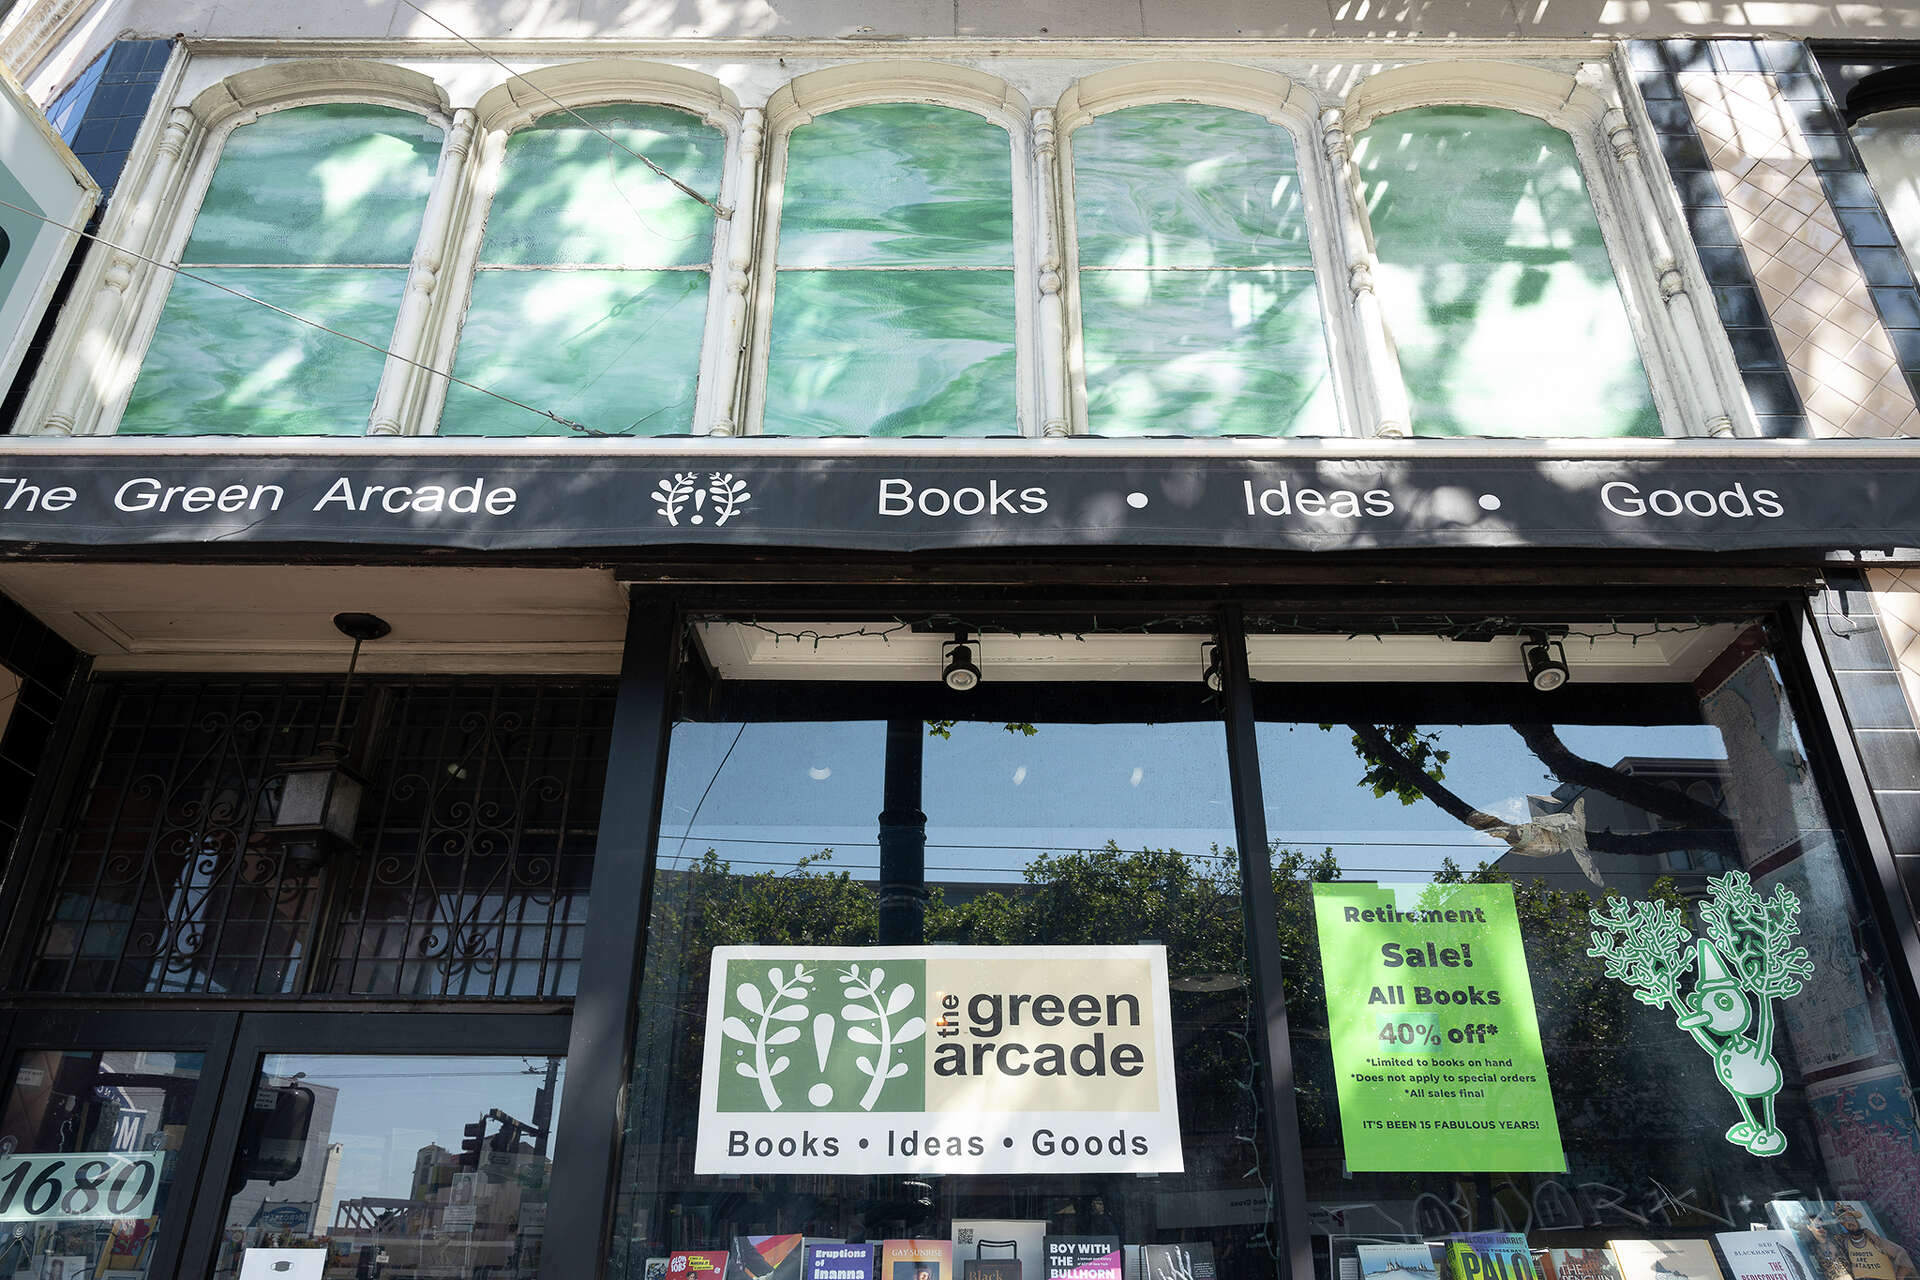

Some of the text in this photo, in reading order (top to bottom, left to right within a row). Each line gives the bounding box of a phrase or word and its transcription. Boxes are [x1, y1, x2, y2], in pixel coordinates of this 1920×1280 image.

[0, 476, 517, 516] The Green Arcade
[877, 478, 1785, 518] Books Ideas Goods
[1344, 904, 1487, 924] Retirement
[1381, 941, 1474, 969] Sale!
[1368, 985, 1502, 1006] All Books
[938, 992, 1141, 1039] the green
[1378, 1022, 1442, 1047] 40%
[933, 1033, 1145, 1077] arcade
[1417, 1058, 1429, 1068] to
[1431, 1057, 1465, 1068] books
[1468, 1060, 1482, 1068] on
[1485, 1057, 1513, 1068] hand
[1387, 1073, 1407, 1083] not
[1409, 1073, 1440, 1085] apply
[1443, 1073, 1455, 1083] to
[1458, 1072, 1497, 1085] special
[1500, 1072, 1537, 1083] orders
[1428, 1088, 1457, 1099] sales
[1459, 1088, 1485, 1099] final
[1362, 1120, 1540, 1130] IT'S BEEN 15 FABULOUS YEARS!
[727, 1128, 1149, 1158] Books Ideas Goods
[0, 1160, 155, 1216] 1680
[1496, 1236, 1524, 1245] HARRIS
[815, 1249, 866, 1259] Eruptions
[1050, 1243, 1111, 1254] BOY WITH
[815, 1259, 825, 1267] of
[1050, 1256, 1074, 1267] THE
[1768, 1262, 1784, 1272] THE
[814, 1269, 865, 1280] Inanna
[969, 1270, 1004, 1280] Black
[1051, 1268, 1116, 1280] BULLHORN
